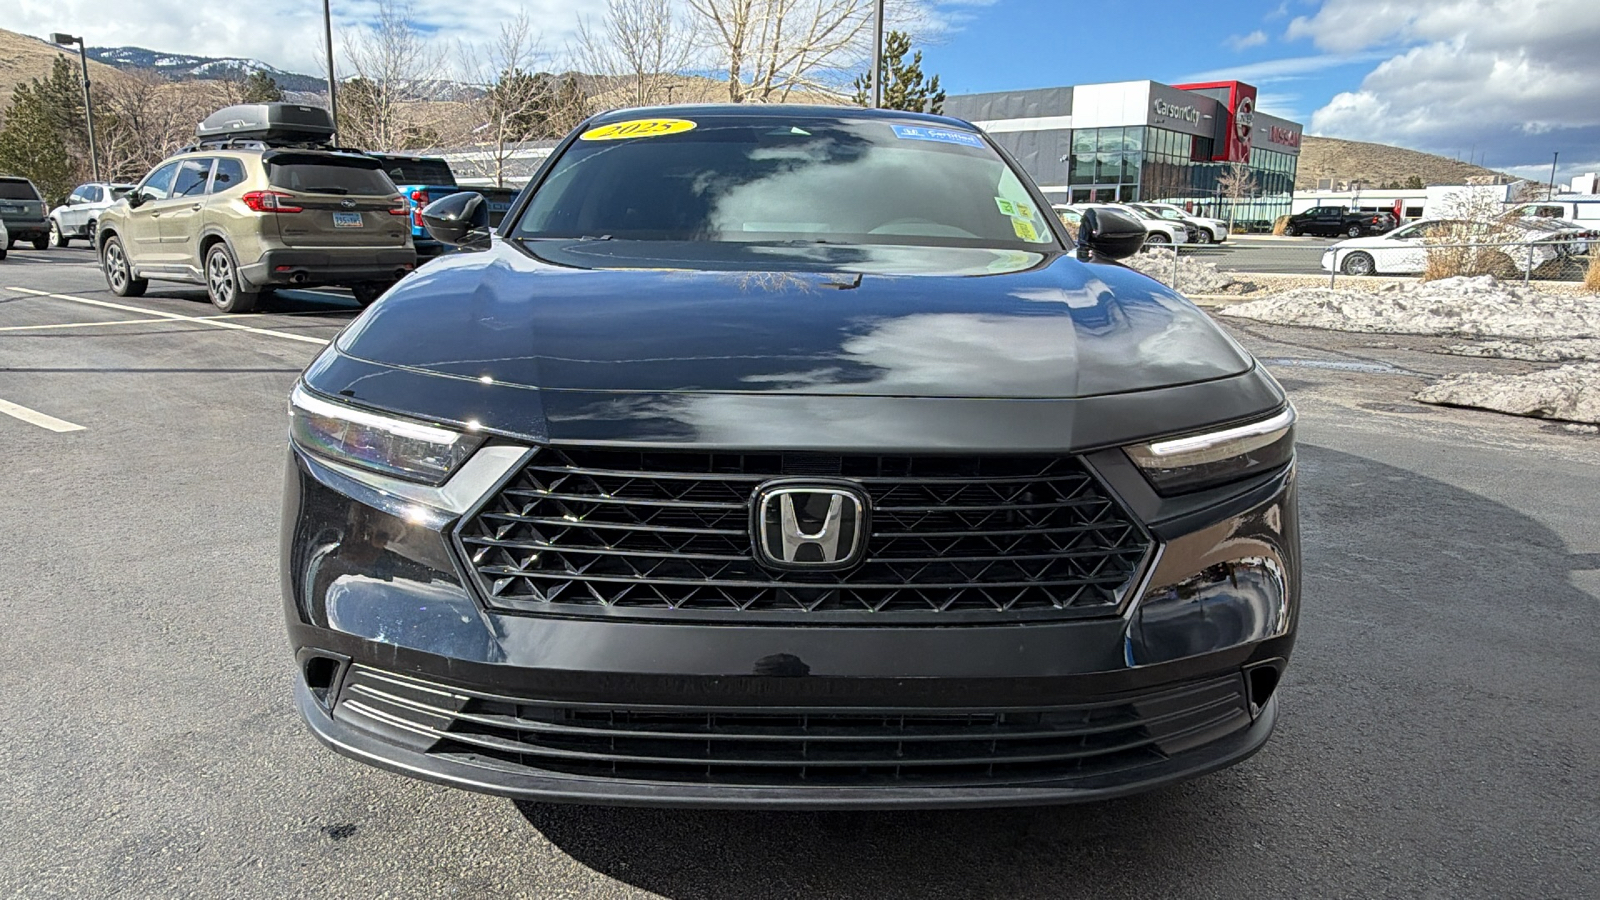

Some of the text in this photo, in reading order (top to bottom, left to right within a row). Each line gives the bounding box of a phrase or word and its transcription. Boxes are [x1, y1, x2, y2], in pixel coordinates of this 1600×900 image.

[1154, 98, 1200, 127] Carson City
[598, 122, 679, 138] 2025
[1269, 124, 1299, 147] NISSAN
